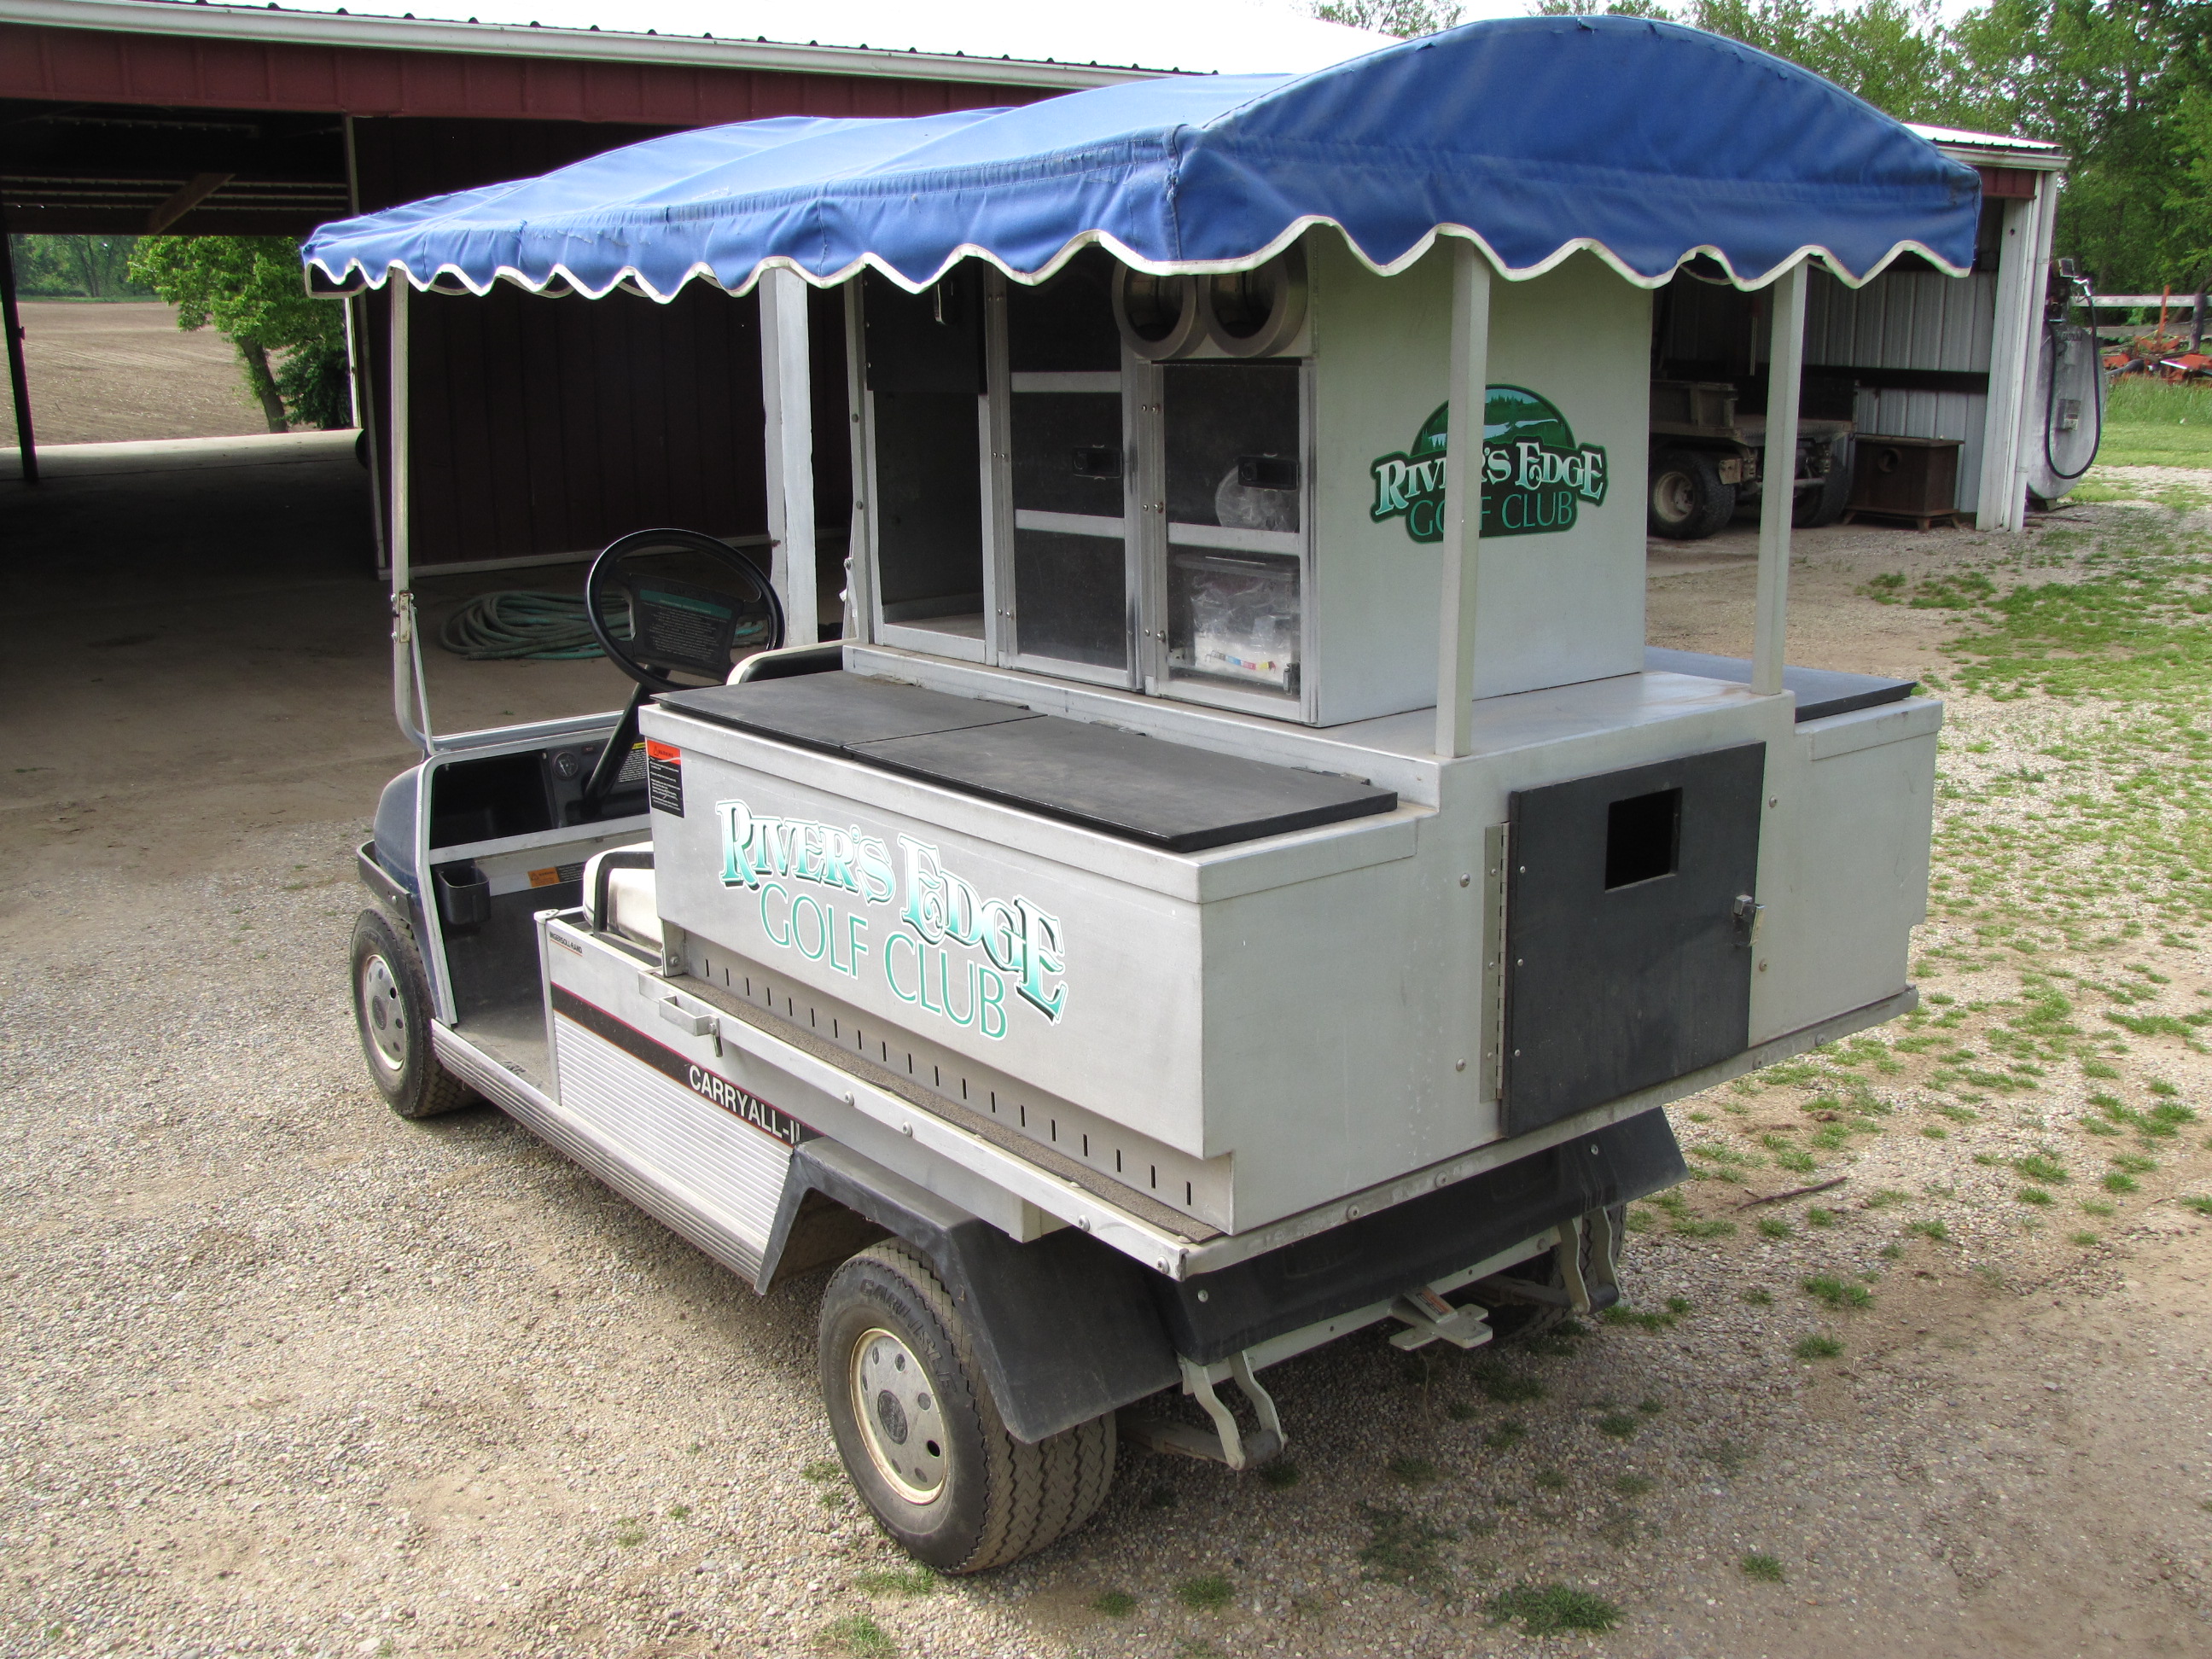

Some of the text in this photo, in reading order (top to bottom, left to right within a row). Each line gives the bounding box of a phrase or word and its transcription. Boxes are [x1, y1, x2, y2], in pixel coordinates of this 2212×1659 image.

[1375, 441, 1604, 515] RIV'S EDGE
[1409, 491, 1574, 537] GF CLUB
[715, 799, 1068, 1026] RIVER'S EDGE
[760, 882, 1009, 1041] GOLF CLUB
